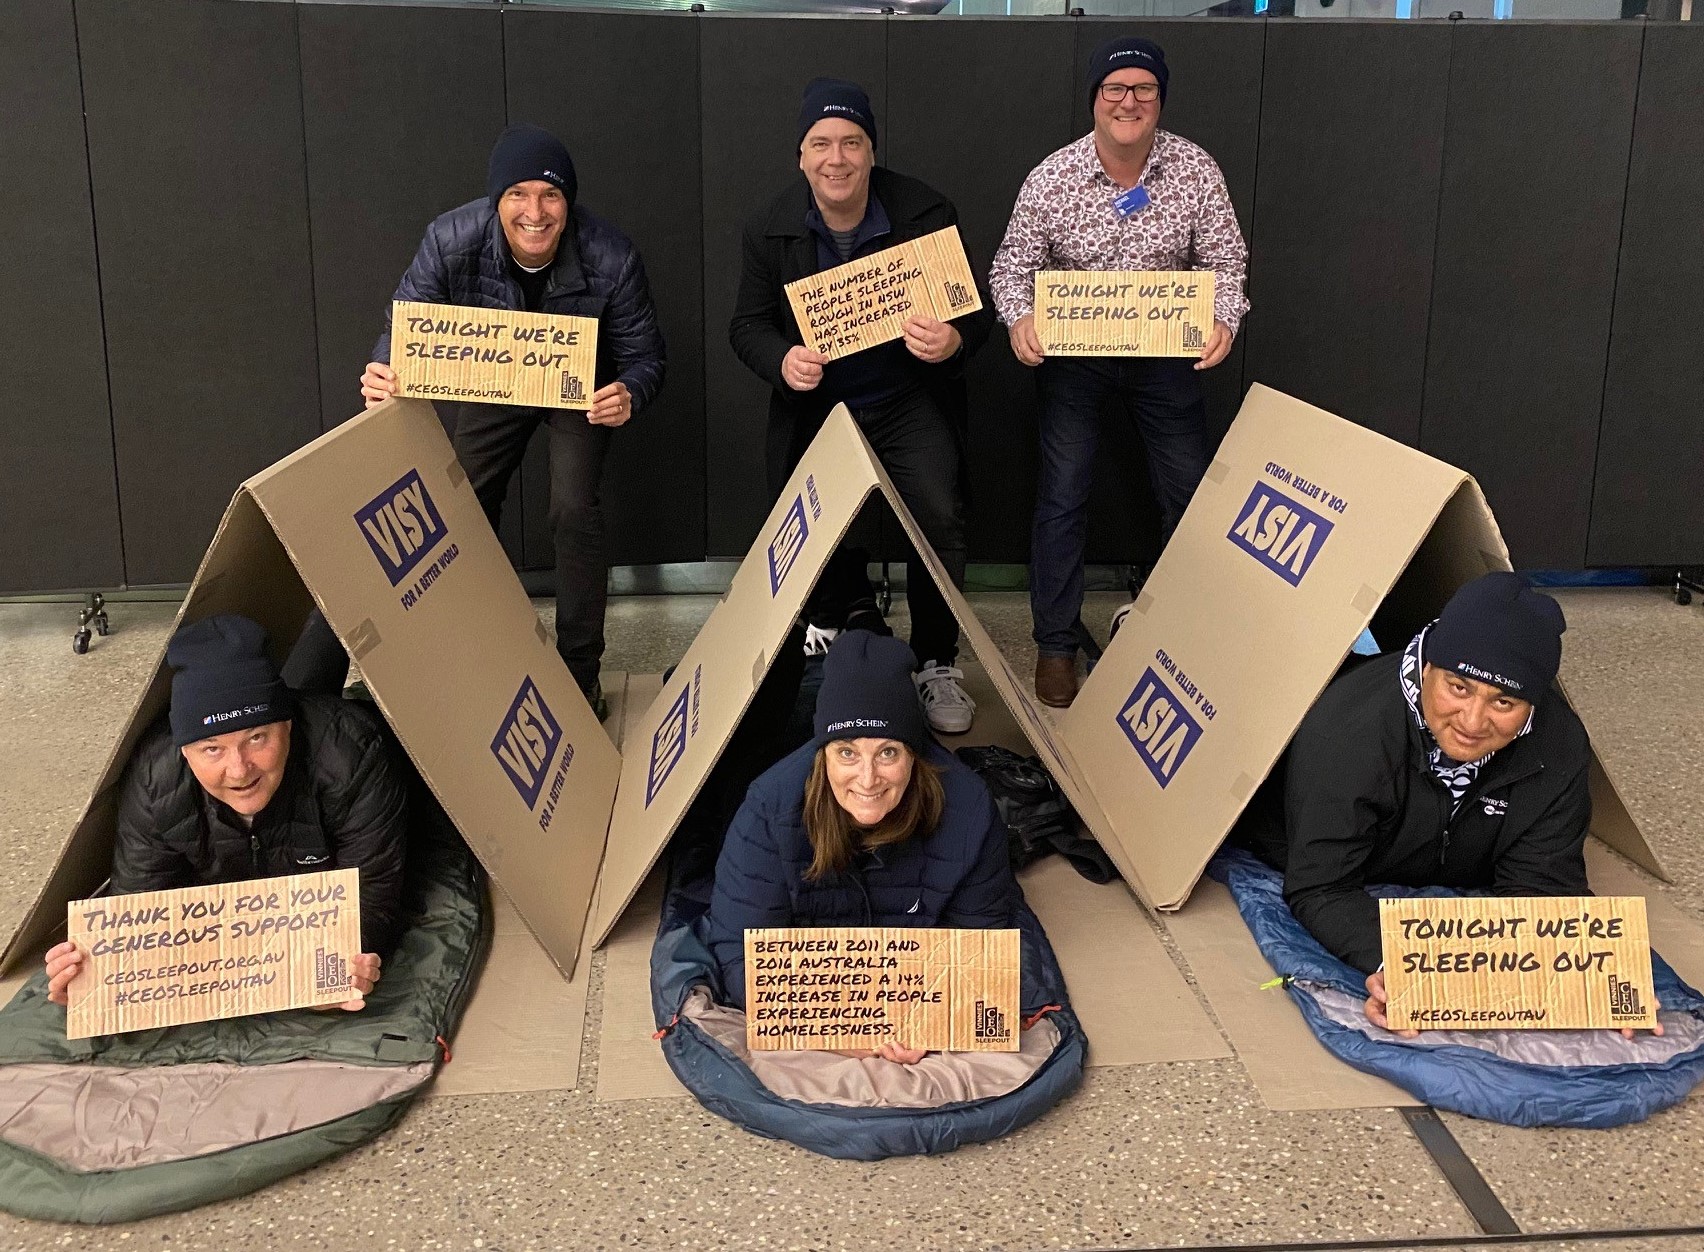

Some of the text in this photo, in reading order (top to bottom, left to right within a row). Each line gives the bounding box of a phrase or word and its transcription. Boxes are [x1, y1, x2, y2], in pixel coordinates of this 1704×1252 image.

[800, 258, 904, 302] THE NUMBER OF
[805, 291, 853, 316] PEOPLE
[856, 267, 922, 297] SLEEPING
[1047, 281, 1198, 298] TONIGHT WE'RE
[810, 287, 905, 328] ROUGH IN NSW
[814, 300, 912, 342] HAS INCREASED
[1046, 306, 1189, 321] SLEEPING OUT
[407, 317, 579, 346] TONIGHT WE'RE
[818, 333, 861, 354] BY 35%
[406, 342, 569, 369] SLEEPING OUT
[1264, 462, 1348, 514] FOR A BETTER WORLD
[362, 479, 436, 568] VISY
[1234, 494, 1317, 576] VISY
[400, 543, 459, 611] FOR A BETTER WORLD
[1155, 649, 1217, 721] FOR A BETTER WORLD
[1465, 664, 1493, 680] HENRY
[212, 710, 242, 723] HENRY
[832, 718, 886, 731] HENRY SCHEIN
[1122, 682, 1189, 778] VISY
[498, 686, 554, 789] VISY
[539, 743, 574, 832] FOR A BETTER WORLD
[83, 884, 347, 932] THANK YOU FOR YOUR
[91, 906, 338, 957] GENEROUS SUPPORT!
[1400, 912, 1624, 940] TONIGHT WE'RE
[754, 939, 920, 954] BETWEEN 2011 AND
[104, 950, 285, 986] CEOSLEEPOUT.ORG.AU
[328, 955, 338, 986] CEO
[756, 956, 898, 970] 2016 AUSTRALIA
[1402, 951, 1614, 973] SLEEPING OUT
[316, 986, 352, 996] SLEEPOUT
[756, 973, 925, 987] EXPERIENCED A 14%
[755, 990, 943, 1004] INCREASE IN PEOPLE
[1620, 983, 1632, 1013] CEO
[756, 1006, 886, 1020] EXPERIENCING
[987, 1009, 996, 1036] CEO
[756, 1023, 896, 1037] HOMELESSNESS.
